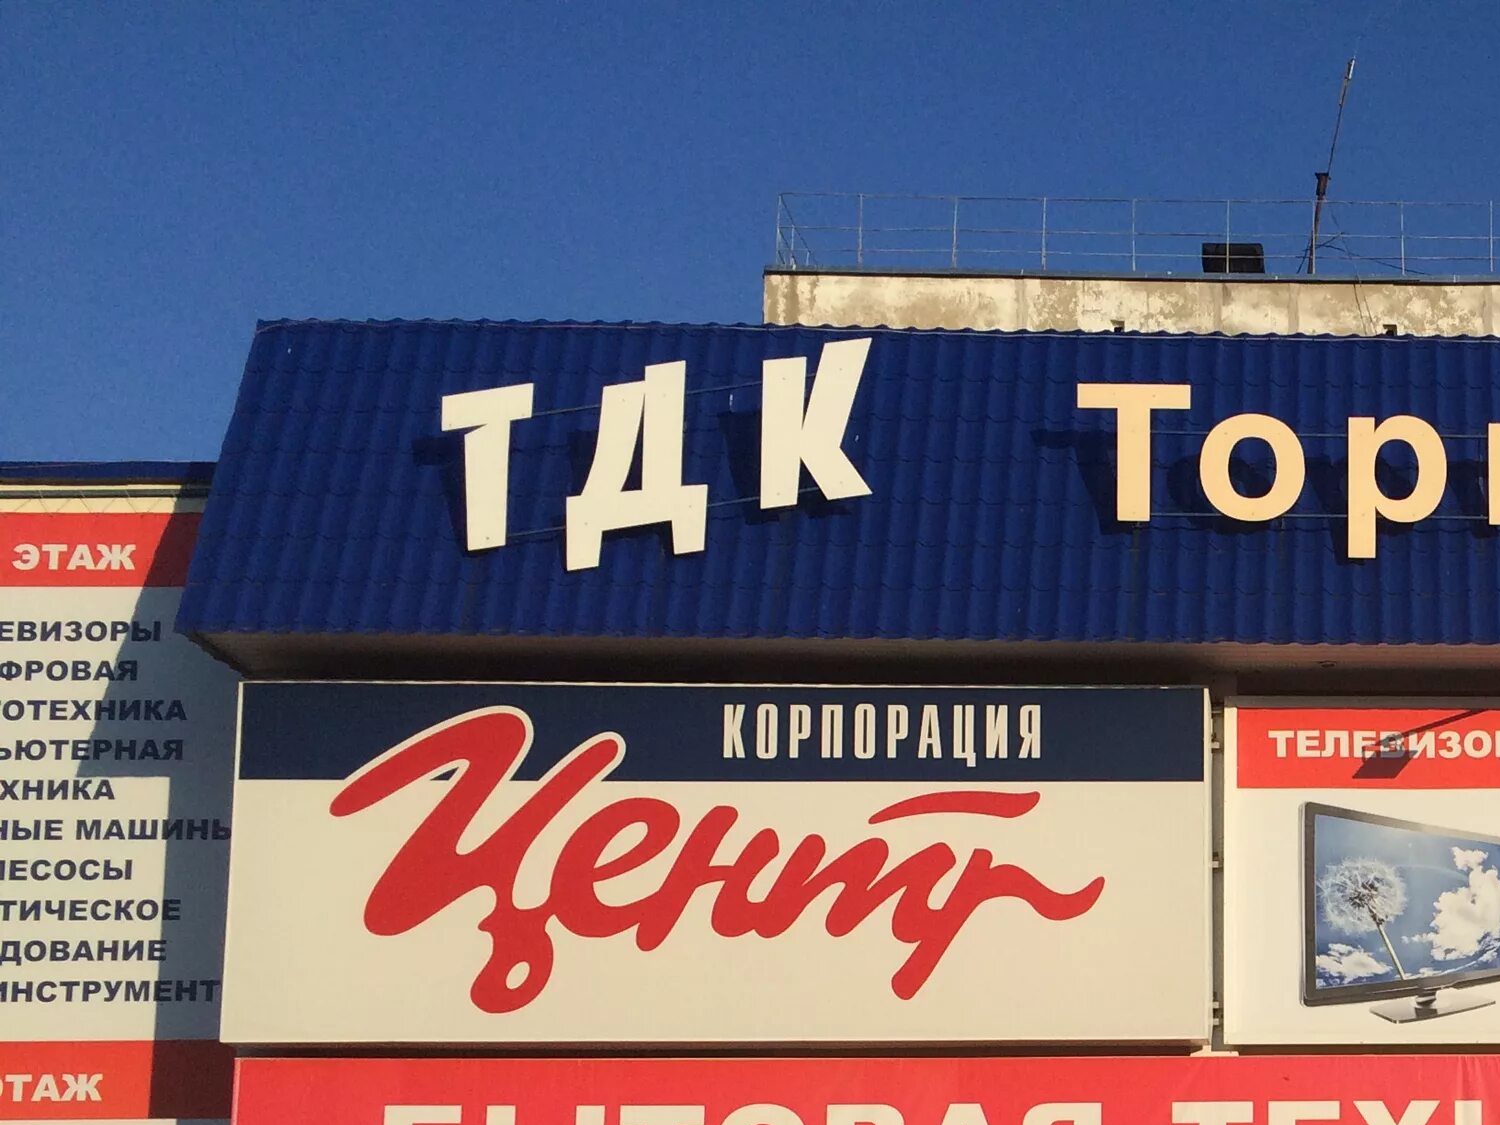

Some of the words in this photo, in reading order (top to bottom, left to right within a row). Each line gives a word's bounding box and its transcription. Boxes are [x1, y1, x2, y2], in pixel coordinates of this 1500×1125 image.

[441, 338, 872, 571] ТДК
[12, 543, 136, 571] ЭТАЖ
[723, 703, 1042, 767] КОРПОРАЦИЯ
[0, 859, 132, 881] ЕСОСЫ
[0, 1073, 104, 1102] ТАЖ
